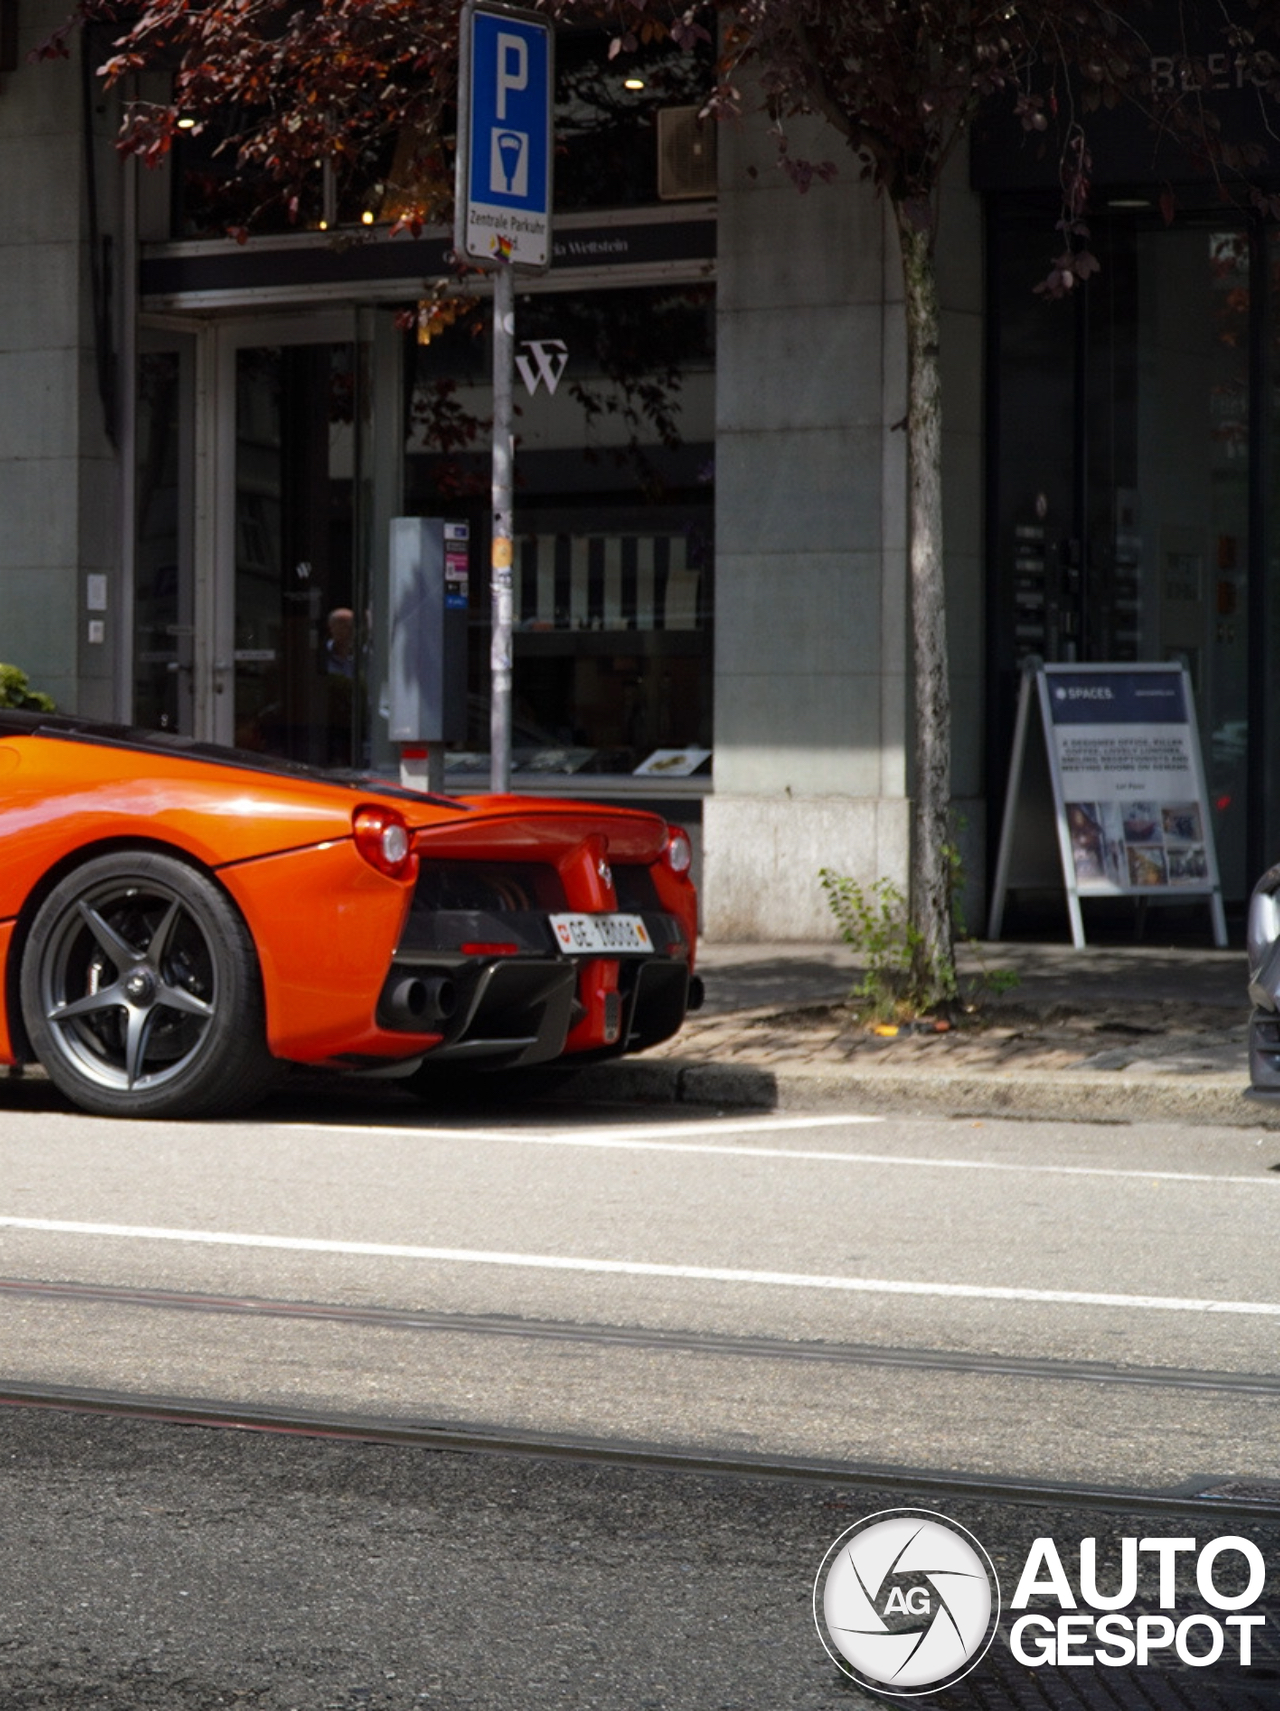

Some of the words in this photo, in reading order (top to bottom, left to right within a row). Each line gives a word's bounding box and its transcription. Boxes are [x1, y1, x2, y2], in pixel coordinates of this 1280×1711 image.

[495, 31, 528, 120] P
[470, 209, 508, 230] Zentrale
[511, 215, 546, 235] Parkuhr
[569, 239, 628, 255] Wettstein
[569, 921, 593, 947] GE
